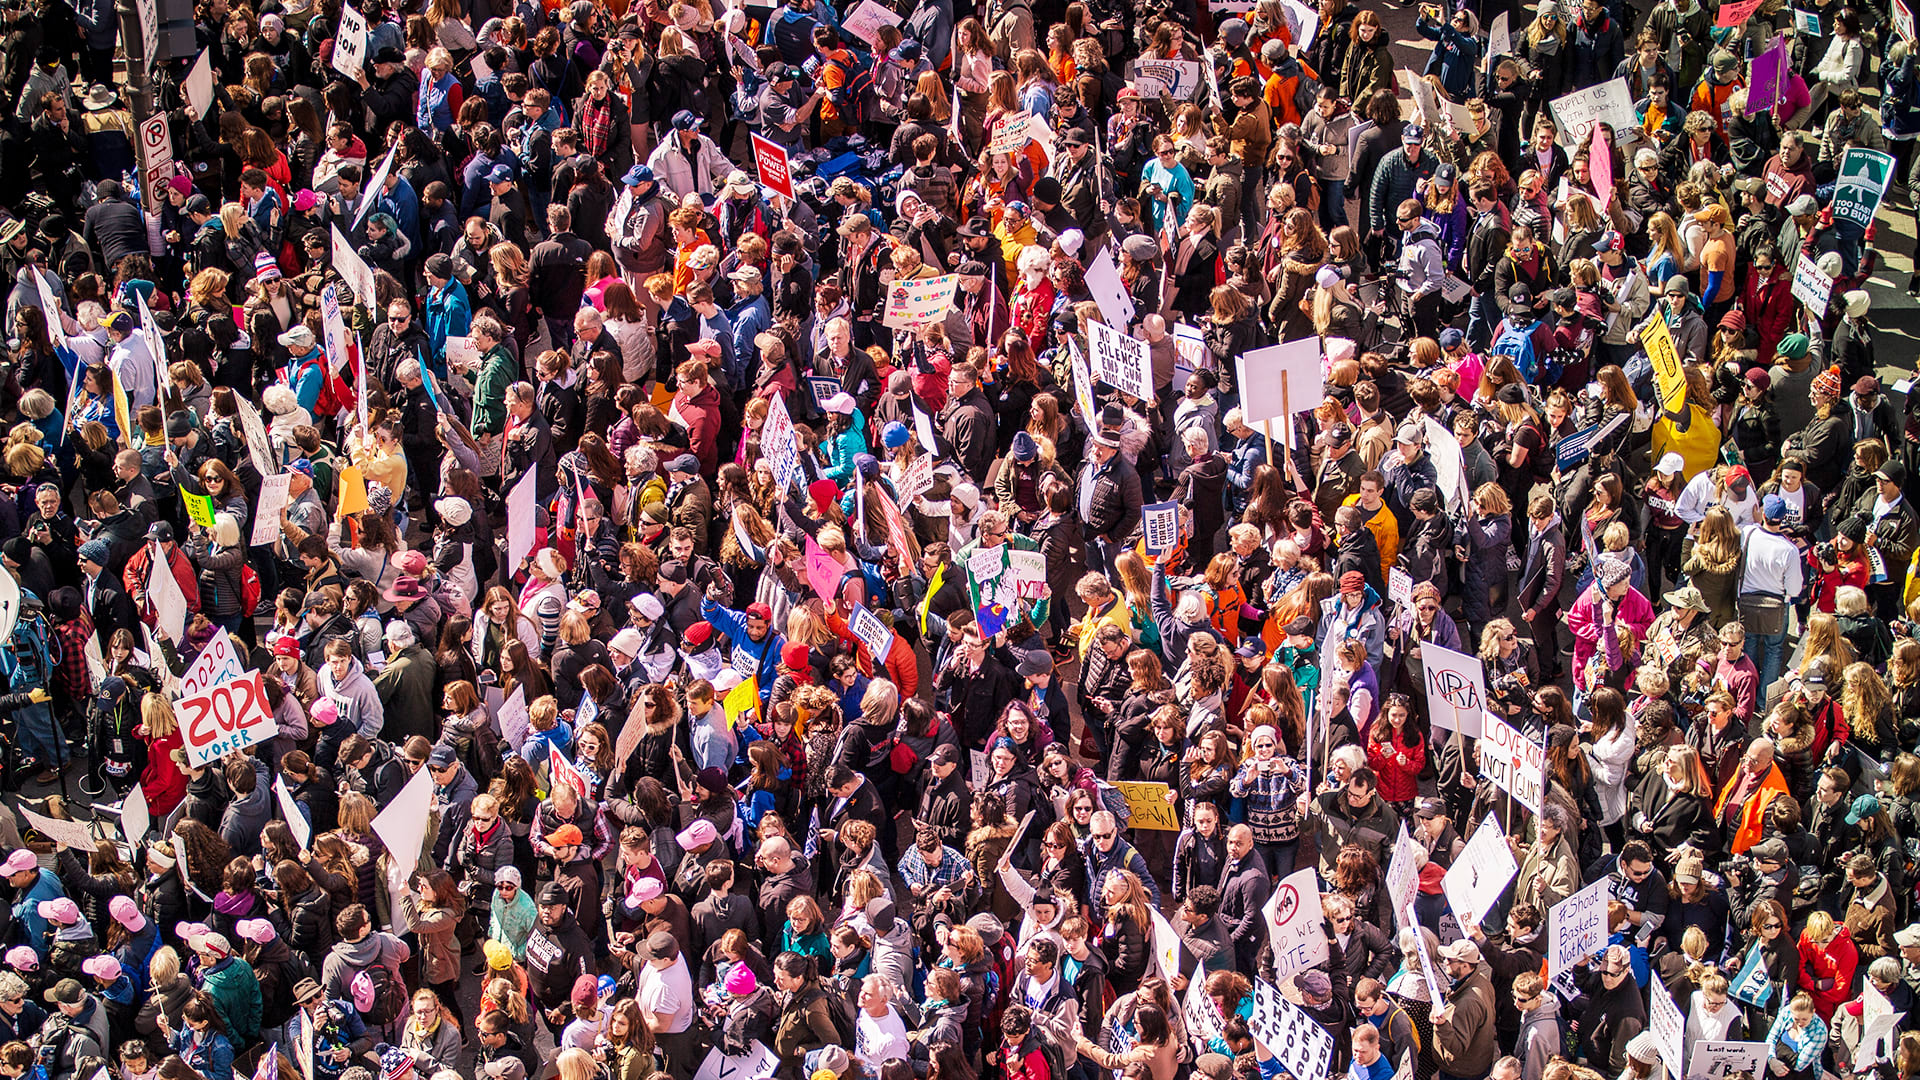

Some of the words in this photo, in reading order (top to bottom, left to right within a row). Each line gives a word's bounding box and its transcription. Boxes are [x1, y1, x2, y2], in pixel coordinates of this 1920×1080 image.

[1592, 87, 1608, 100] US
[759, 154, 787, 175] POWER
[1850, 151, 1865, 159] TWO
[1865, 152, 1888, 164] THINGS
[1836, 199, 1852, 209] TOO
[1848, 208, 1870, 223] BUY
[926, 275, 956, 285] WANT
[890, 311, 913, 319] NOT
[1097, 327, 1110, 344] NO
[1118, 334, 1142, 358] MORE
[1097, 342, 1141, 372] SILENCE
[1101, 356, 1119, 375] END
[1123, 364, 1142, 384] GUN
[1102, 371, 1141, 396] VIOLENCE
[1150, 518, 1158, 546] MARCH
[861, 613, 883, 636] MARCH
[1656, 635, 1674, 664] VOTE
[1427, 667, 1482, 711] NRA
[1484, 714, 1522, 759] LOVE
[1526, 740, 1543, 773] KIDS
[1483, 753, 1506, 783] NOT
[1515, 773, 1541, 808] GUNS
[1121, 785, 1167, 802] NEVER
[1558, 891, 1598, 925] #Shoot
[1295, 920, 1314, 938] WE
[1559, 914, 1599, 946] Baskets
[1278, 944, 1310, 977] OTE
[1706, 1044, 1724, 1052] Last
